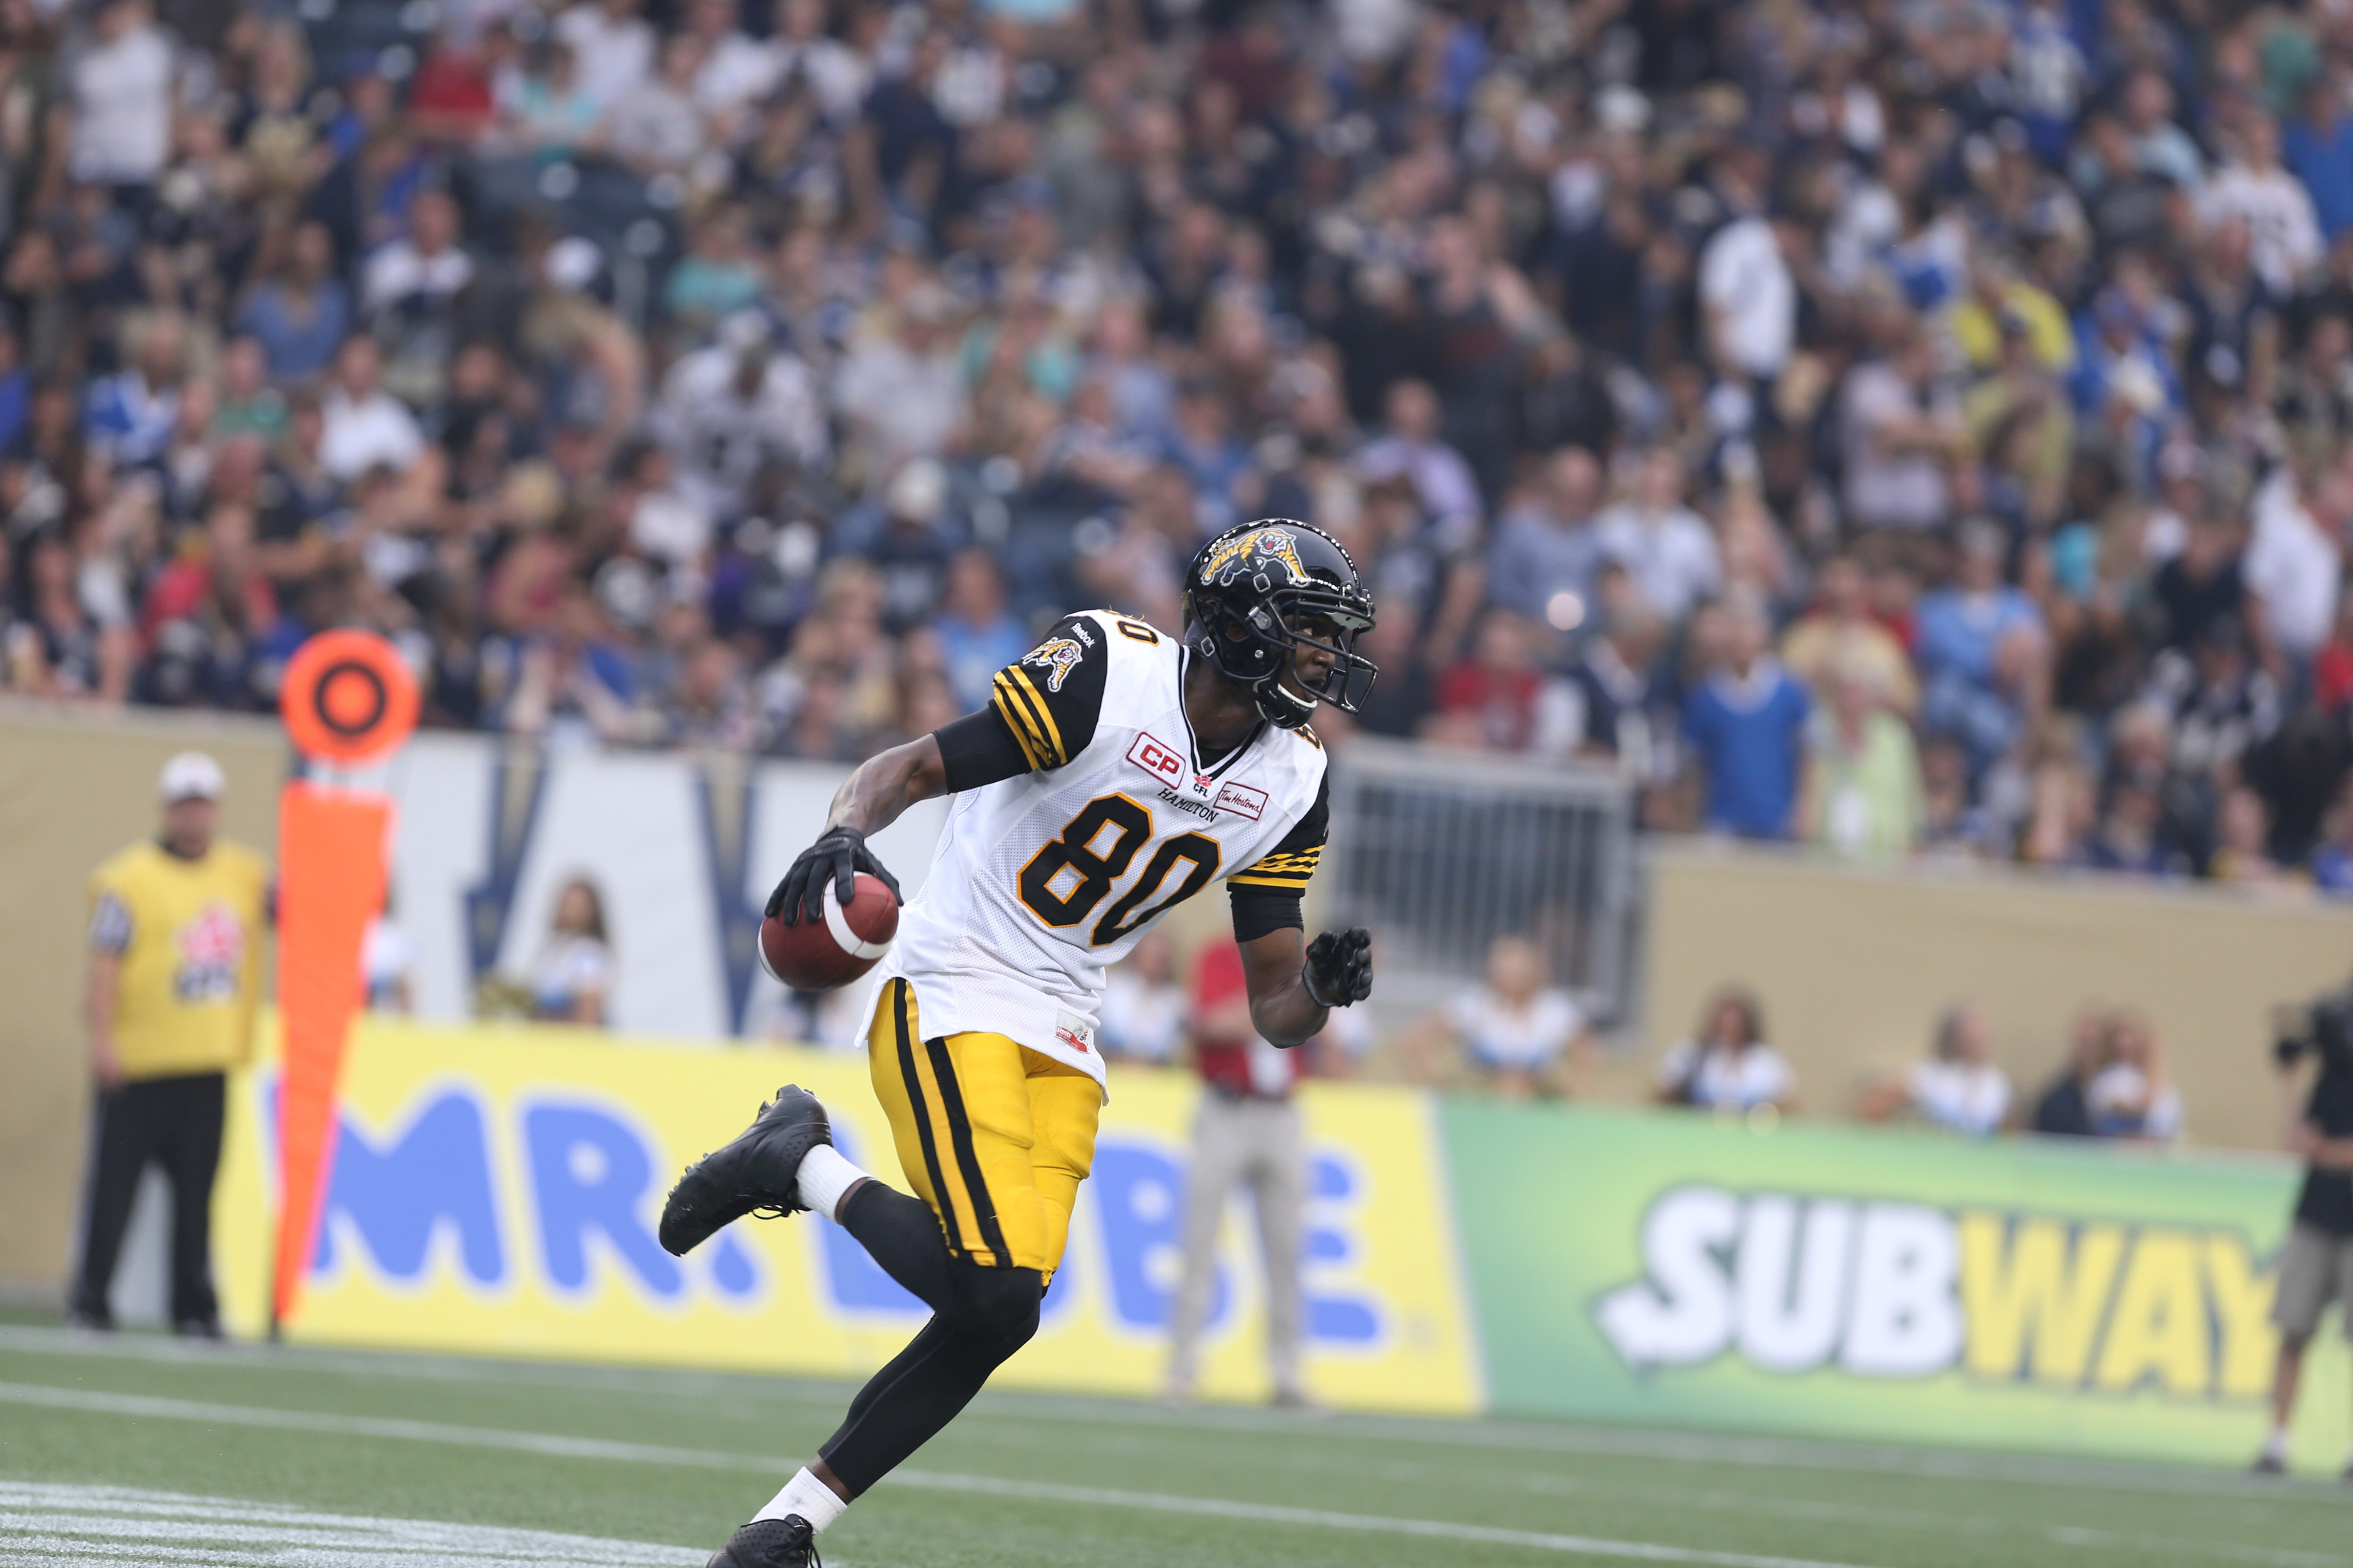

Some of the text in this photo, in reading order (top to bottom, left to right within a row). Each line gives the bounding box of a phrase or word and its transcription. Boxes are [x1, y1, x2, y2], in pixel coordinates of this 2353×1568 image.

[1071, 622, 1096, 648] Reebok
[1140, 744, 1179, 774] CP
[1157, 787, 1220, 823] HAMILTON
[1193, 783, 1208, 798] CFL
[1218, 790, 1232, 804] Tim
[1017, 792, 1222, 947] 80
[1593, 1184, 2284, 1404] SUBWAY
